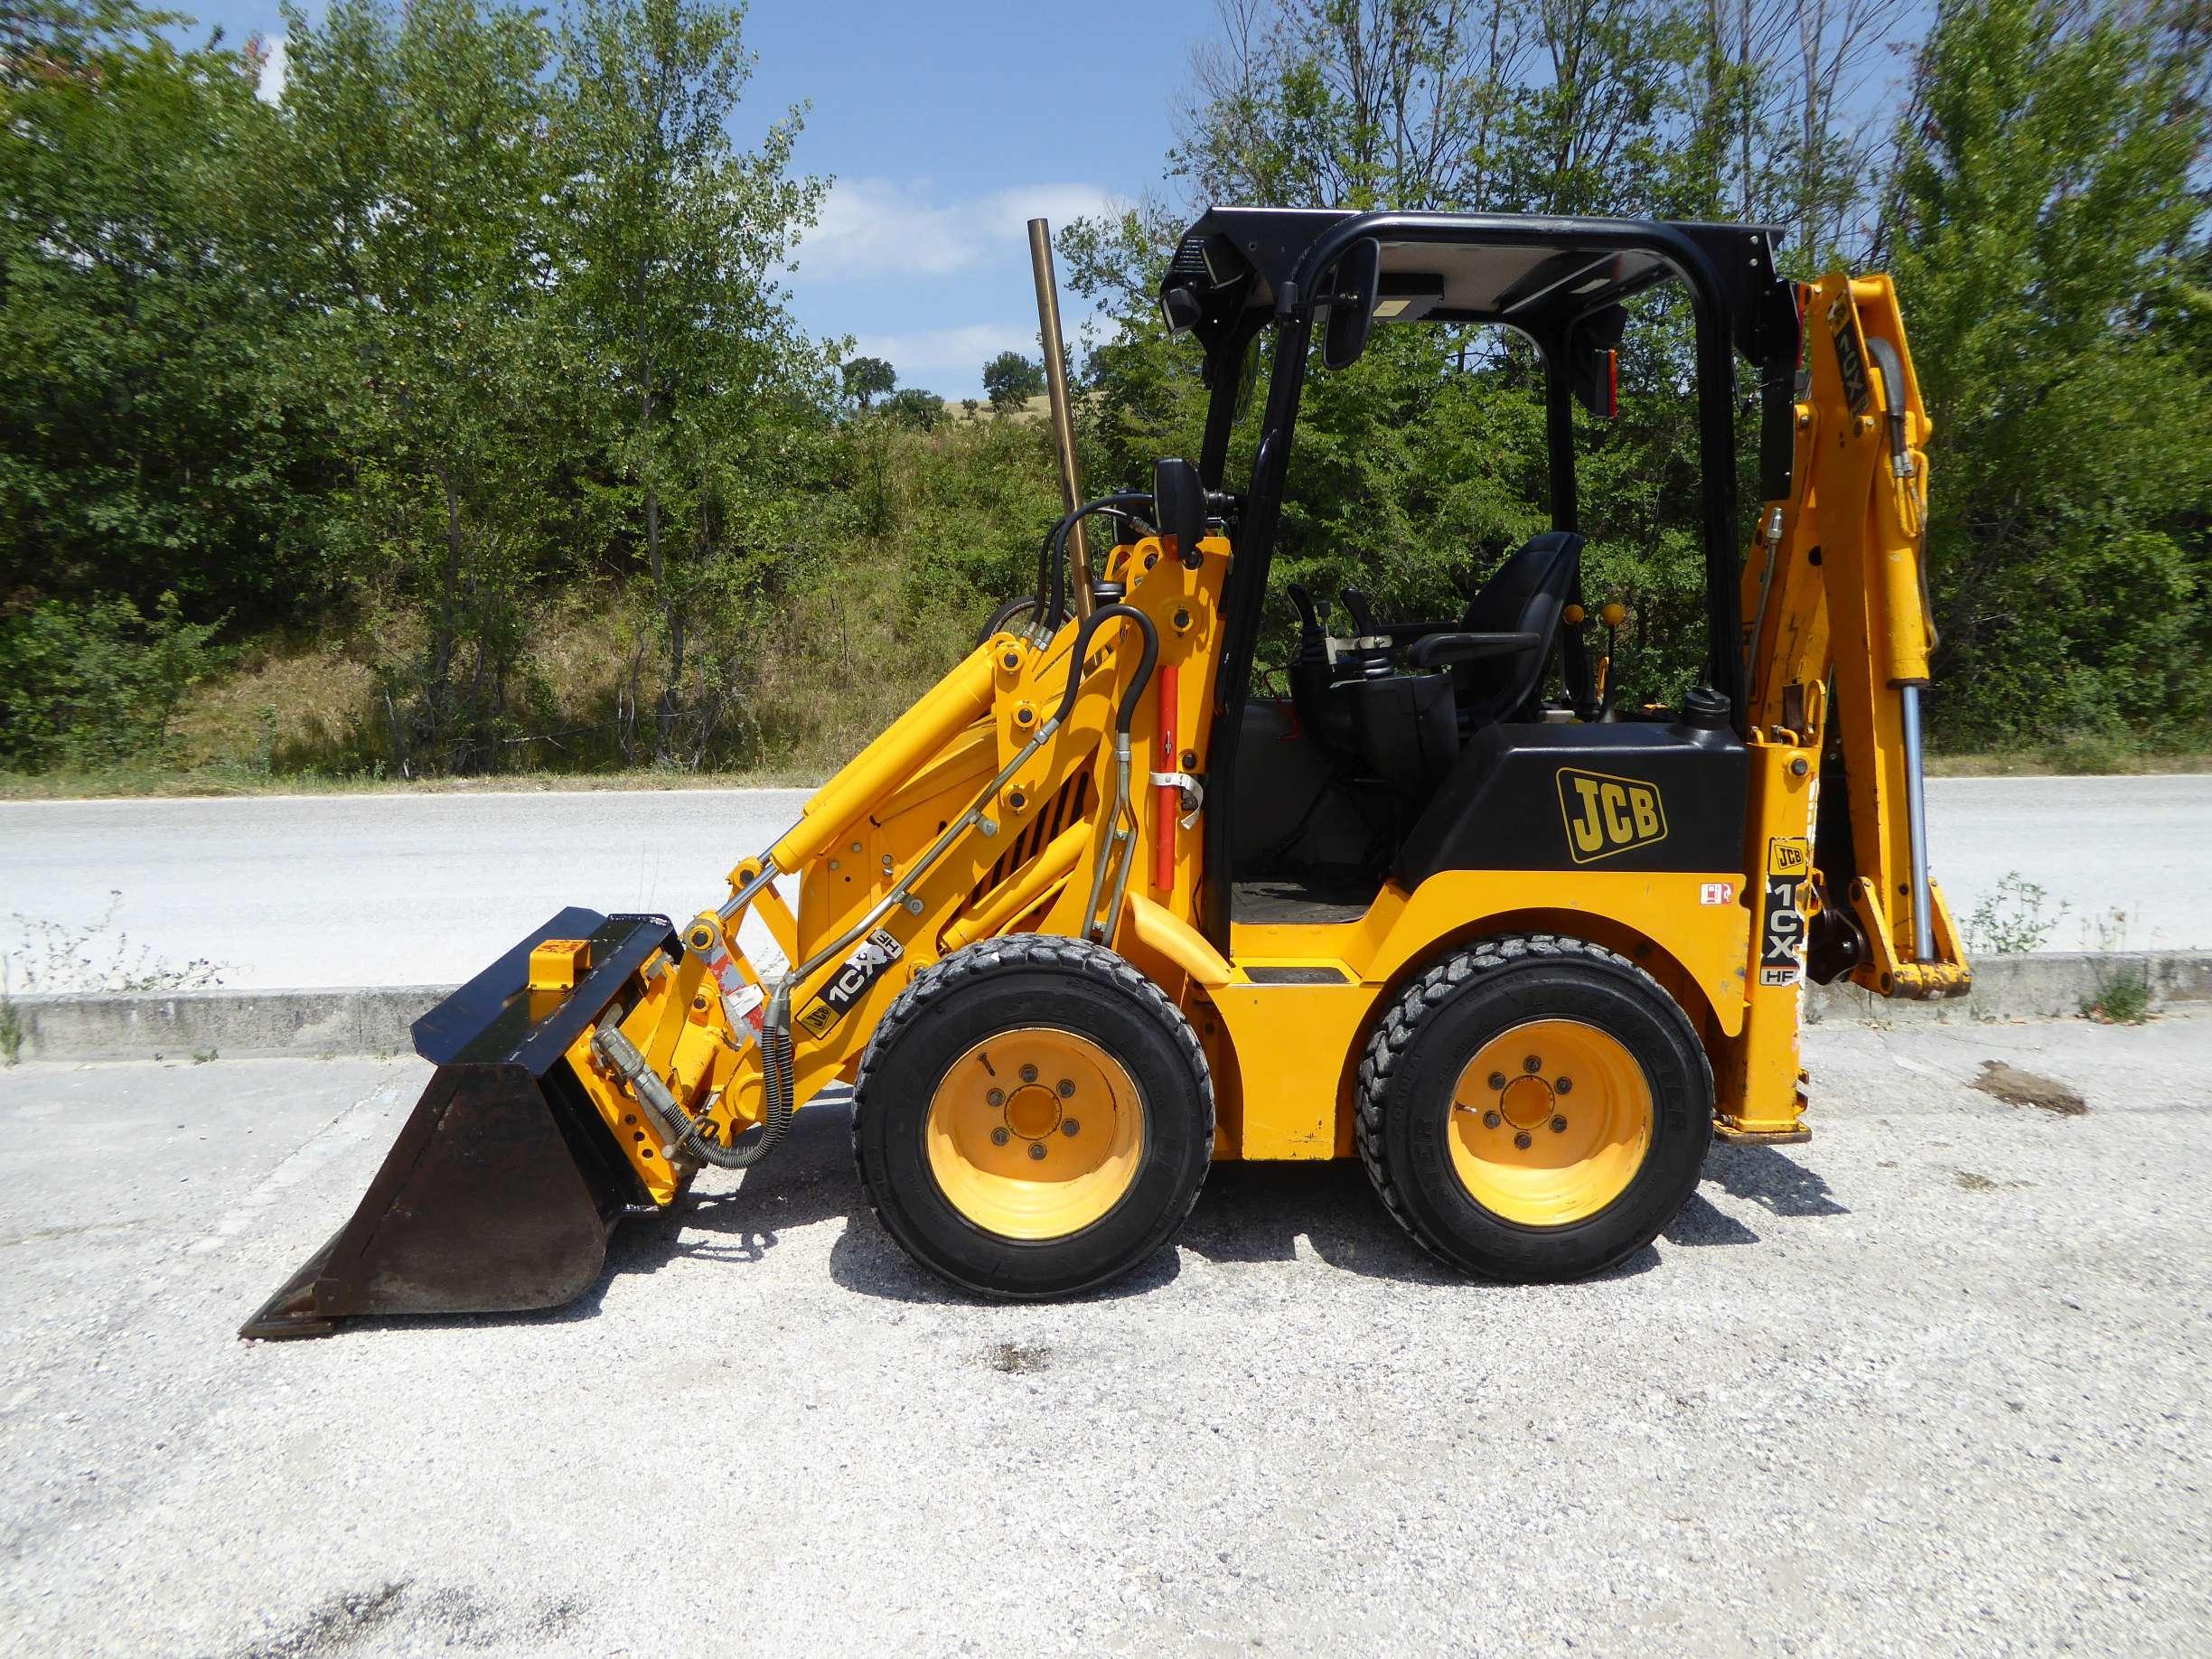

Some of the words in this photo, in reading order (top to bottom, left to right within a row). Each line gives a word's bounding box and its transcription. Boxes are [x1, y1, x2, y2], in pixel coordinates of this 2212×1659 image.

[1572, 778, 1659, 852] JCB
[1779, 848, 1802, 867] JCB
[1767, 884, 1797, 958] 1CX
[877, 934, 899, 953] HF
[829, 948, 886, 1002] 1CX
[1767, 970, 1794, 982] HF
[806, 1006, 830, 1027] JCB
